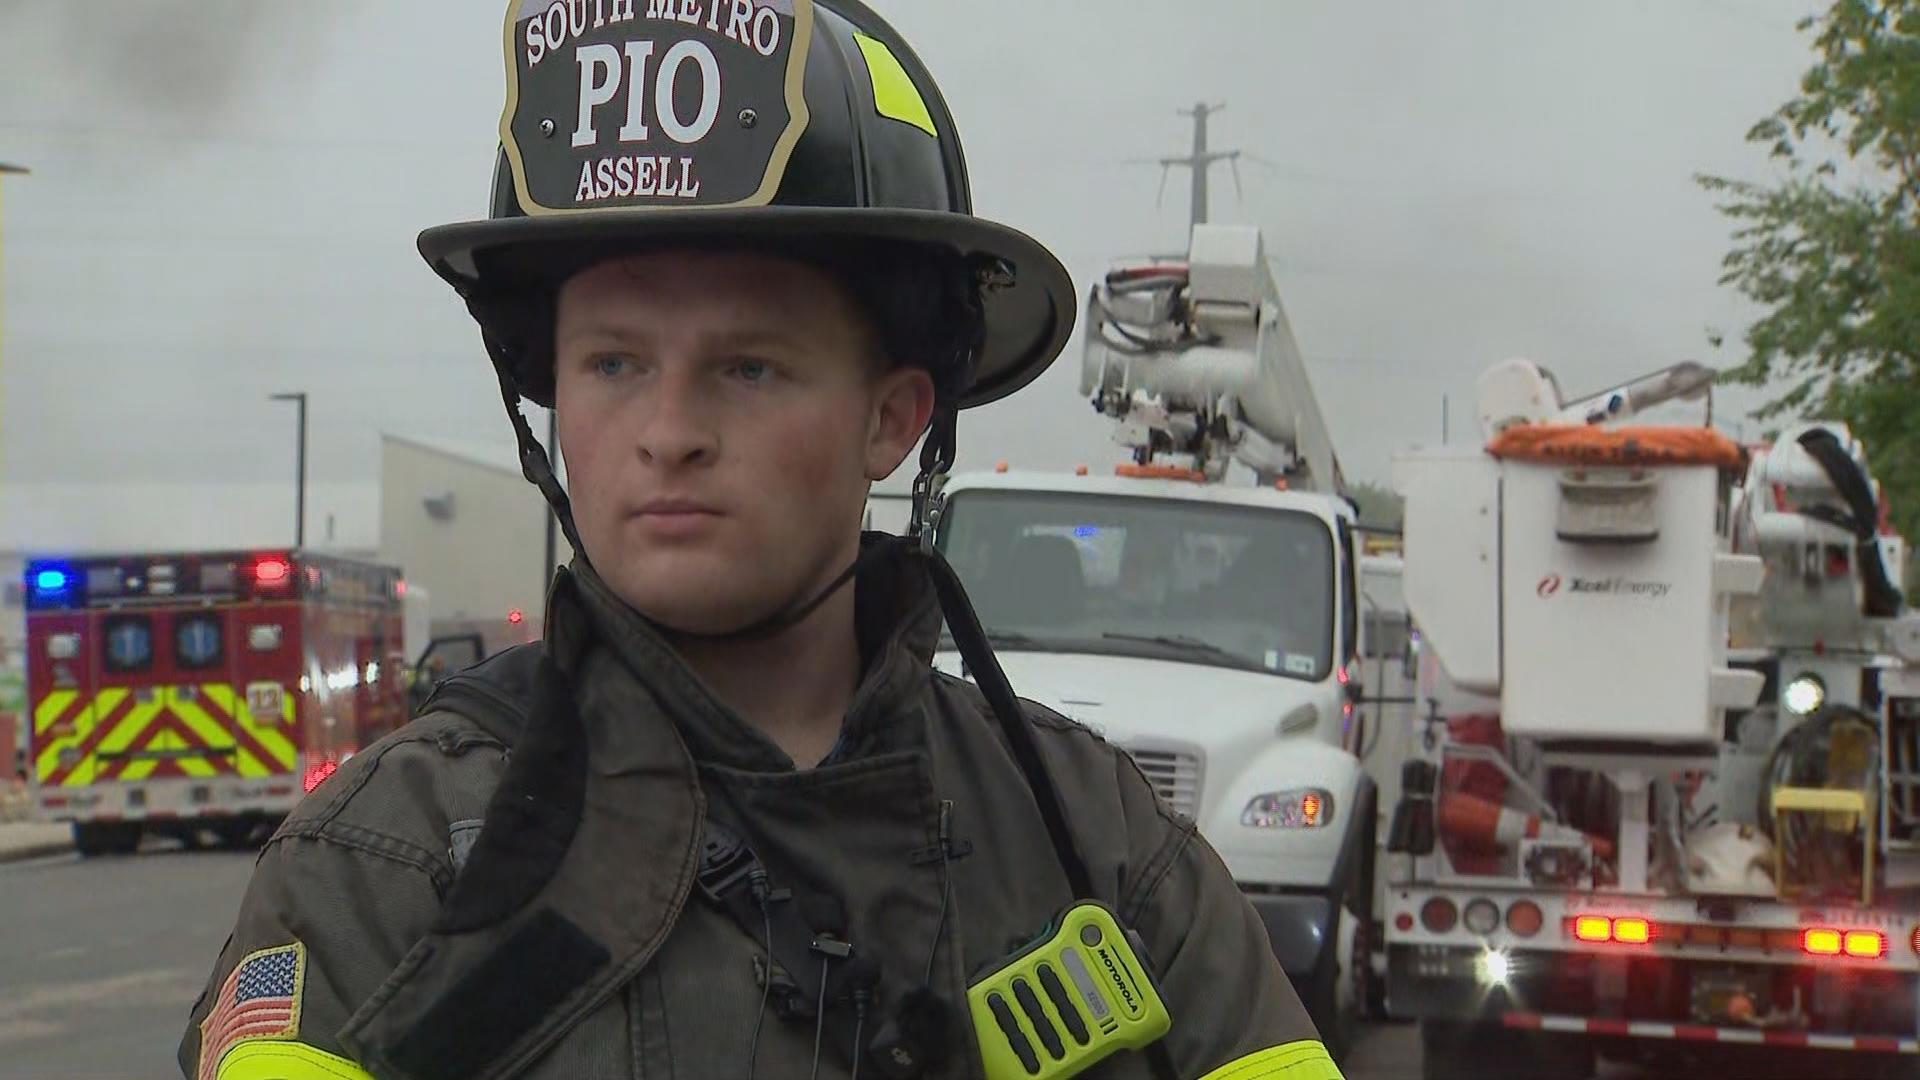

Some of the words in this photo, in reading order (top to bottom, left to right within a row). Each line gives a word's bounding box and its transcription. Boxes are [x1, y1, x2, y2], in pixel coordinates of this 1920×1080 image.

[525, 0, 635, 68] SOUTH
[571, 39, 721, 147] PIO
[574, 156, 700, 201] ASSELL
[1098, 948, 1138, 1013] MOTOROLA
